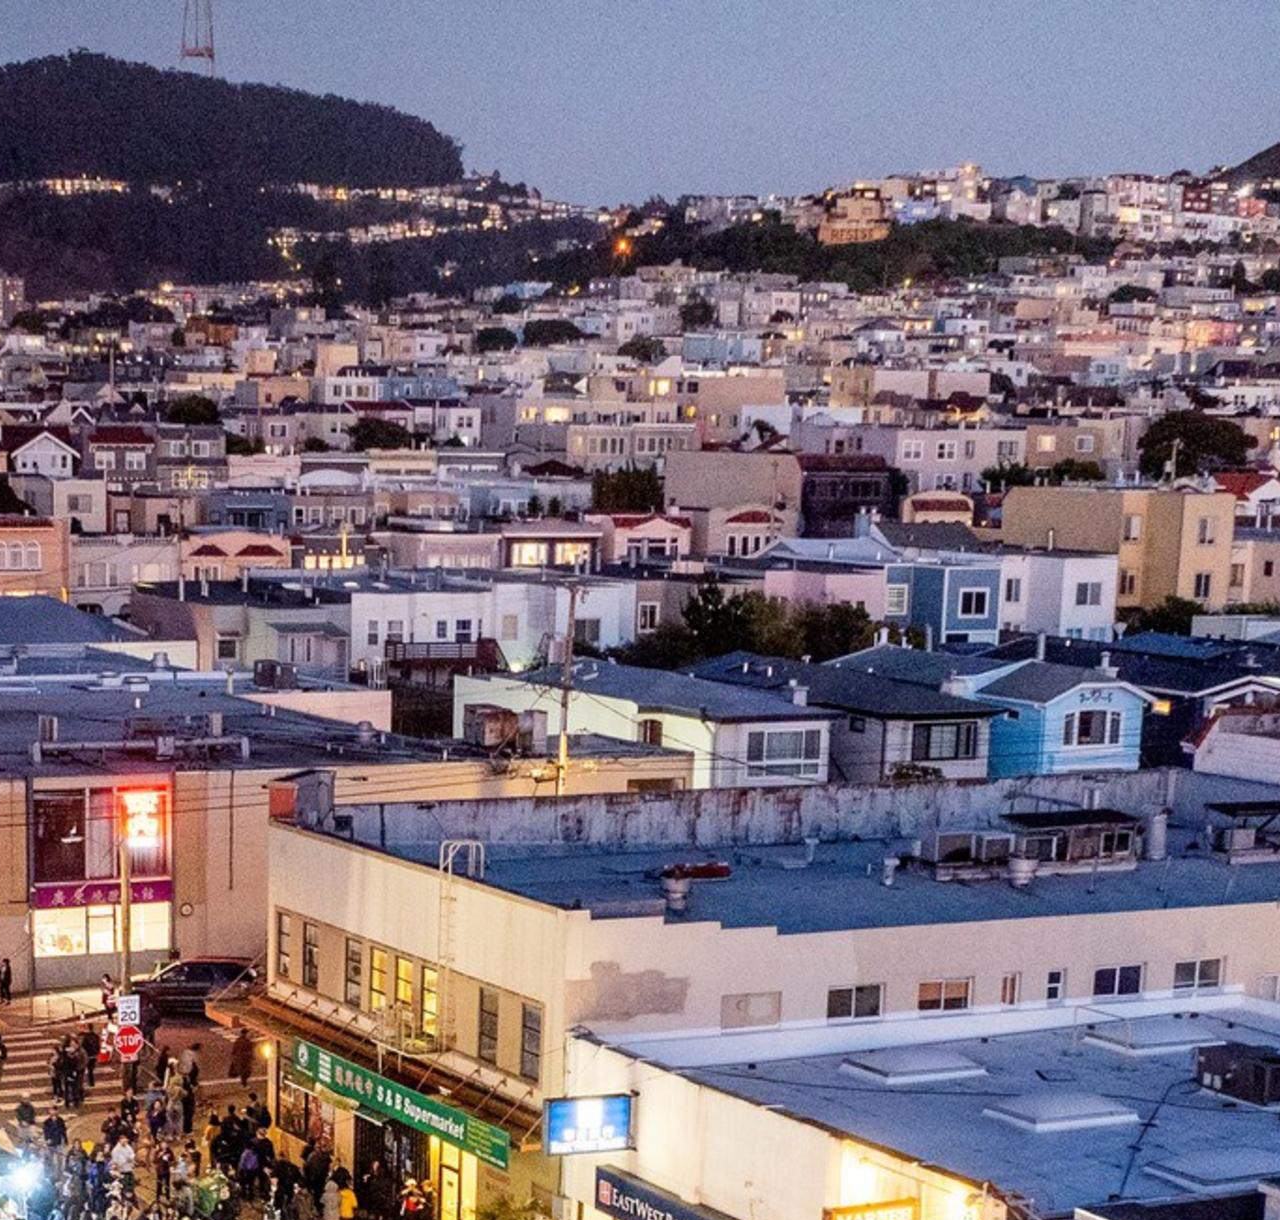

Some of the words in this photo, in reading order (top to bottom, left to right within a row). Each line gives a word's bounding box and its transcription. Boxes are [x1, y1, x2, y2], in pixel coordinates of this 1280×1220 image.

[121, 1010, 138, 1022] 20
[116, 1034, 142, 1048] STOP
[385, 1092, 393, 1106] &
[403, 1098, 465, 1140] Supermarket
